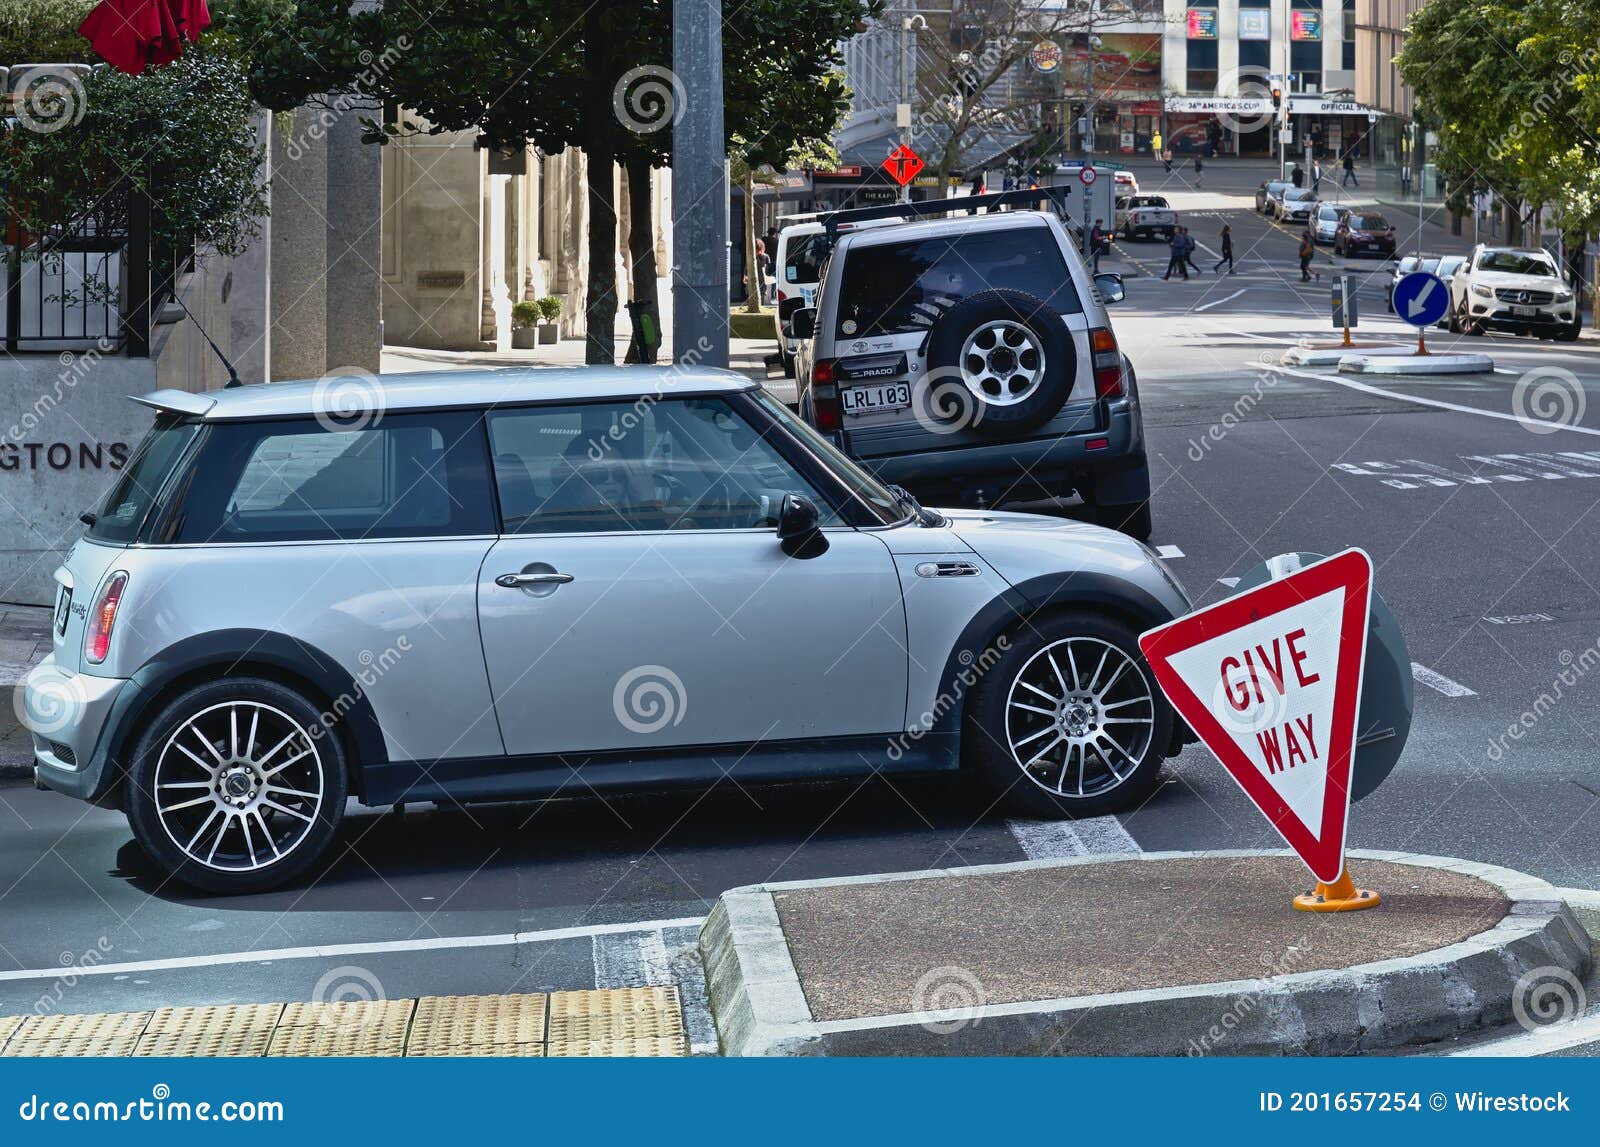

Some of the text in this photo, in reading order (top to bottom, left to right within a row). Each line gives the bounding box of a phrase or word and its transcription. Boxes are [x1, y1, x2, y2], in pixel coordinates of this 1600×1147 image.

[1321, 103, 1354, 111] OFFICIAL
[863, 368, 893, 377] PRADO
[843, 386, 908, 409] LRL103
[0, 442, 129, 470] GTONS
[1220, 628, 1320, 711] GIVE
[1255, 713, 1318, 774] WAY
